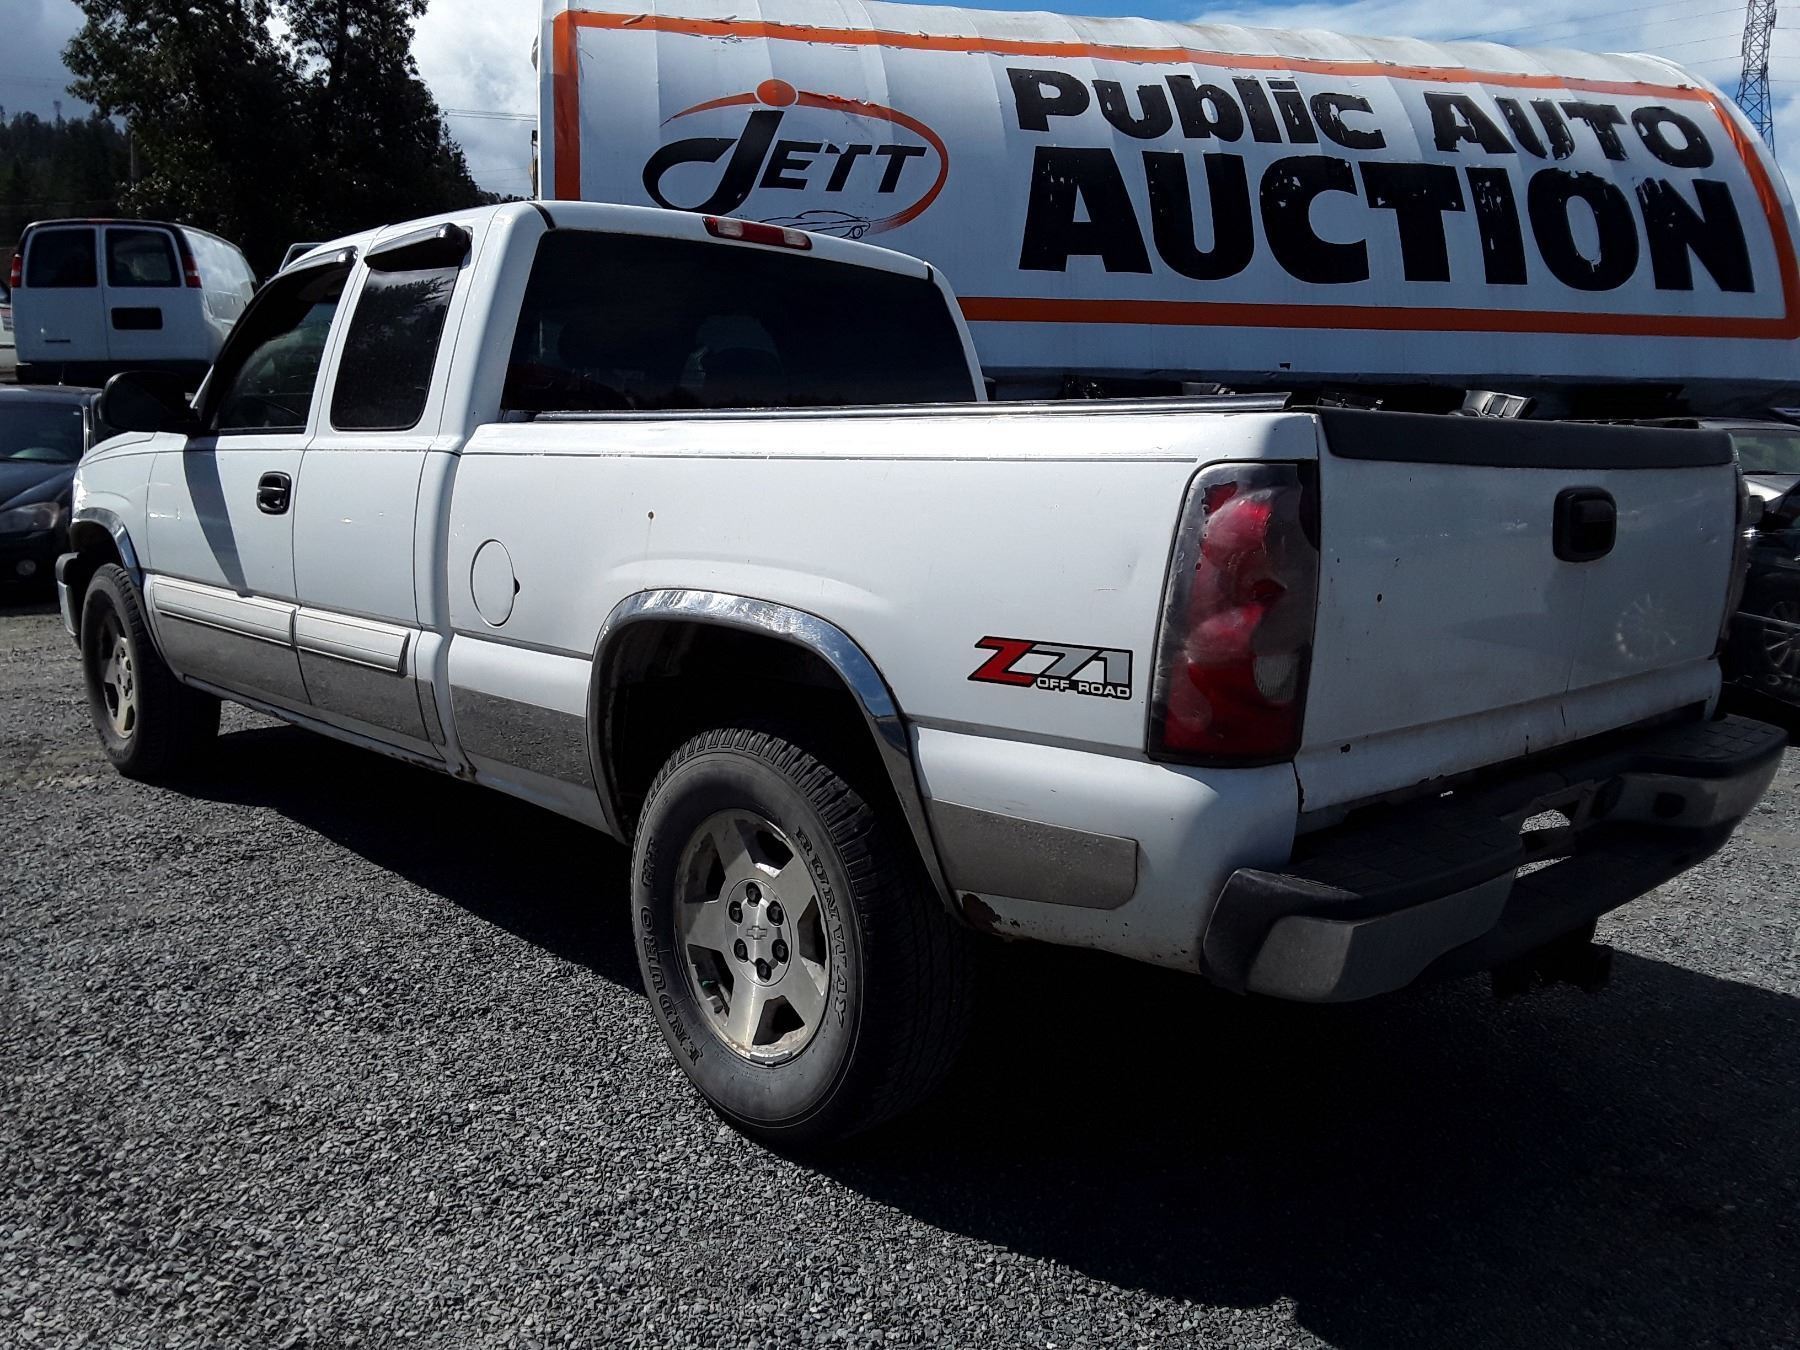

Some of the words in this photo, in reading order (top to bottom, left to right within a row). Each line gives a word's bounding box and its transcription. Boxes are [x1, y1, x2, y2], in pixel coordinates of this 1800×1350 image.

[642, 109, 927, 216] JETT
[1424, 91, 1715, 169] AUTO
[1018, 145, 1756, 293] AUCTION
[967, 635, 1133, 688] Z71
[1036, 676, 1070, 691] OFF
[1078, 681, 1131, 699] ROAD
[796, 826, 848, 1028] RUNWAY
[641, 906, 704, 1066] ENDURO
